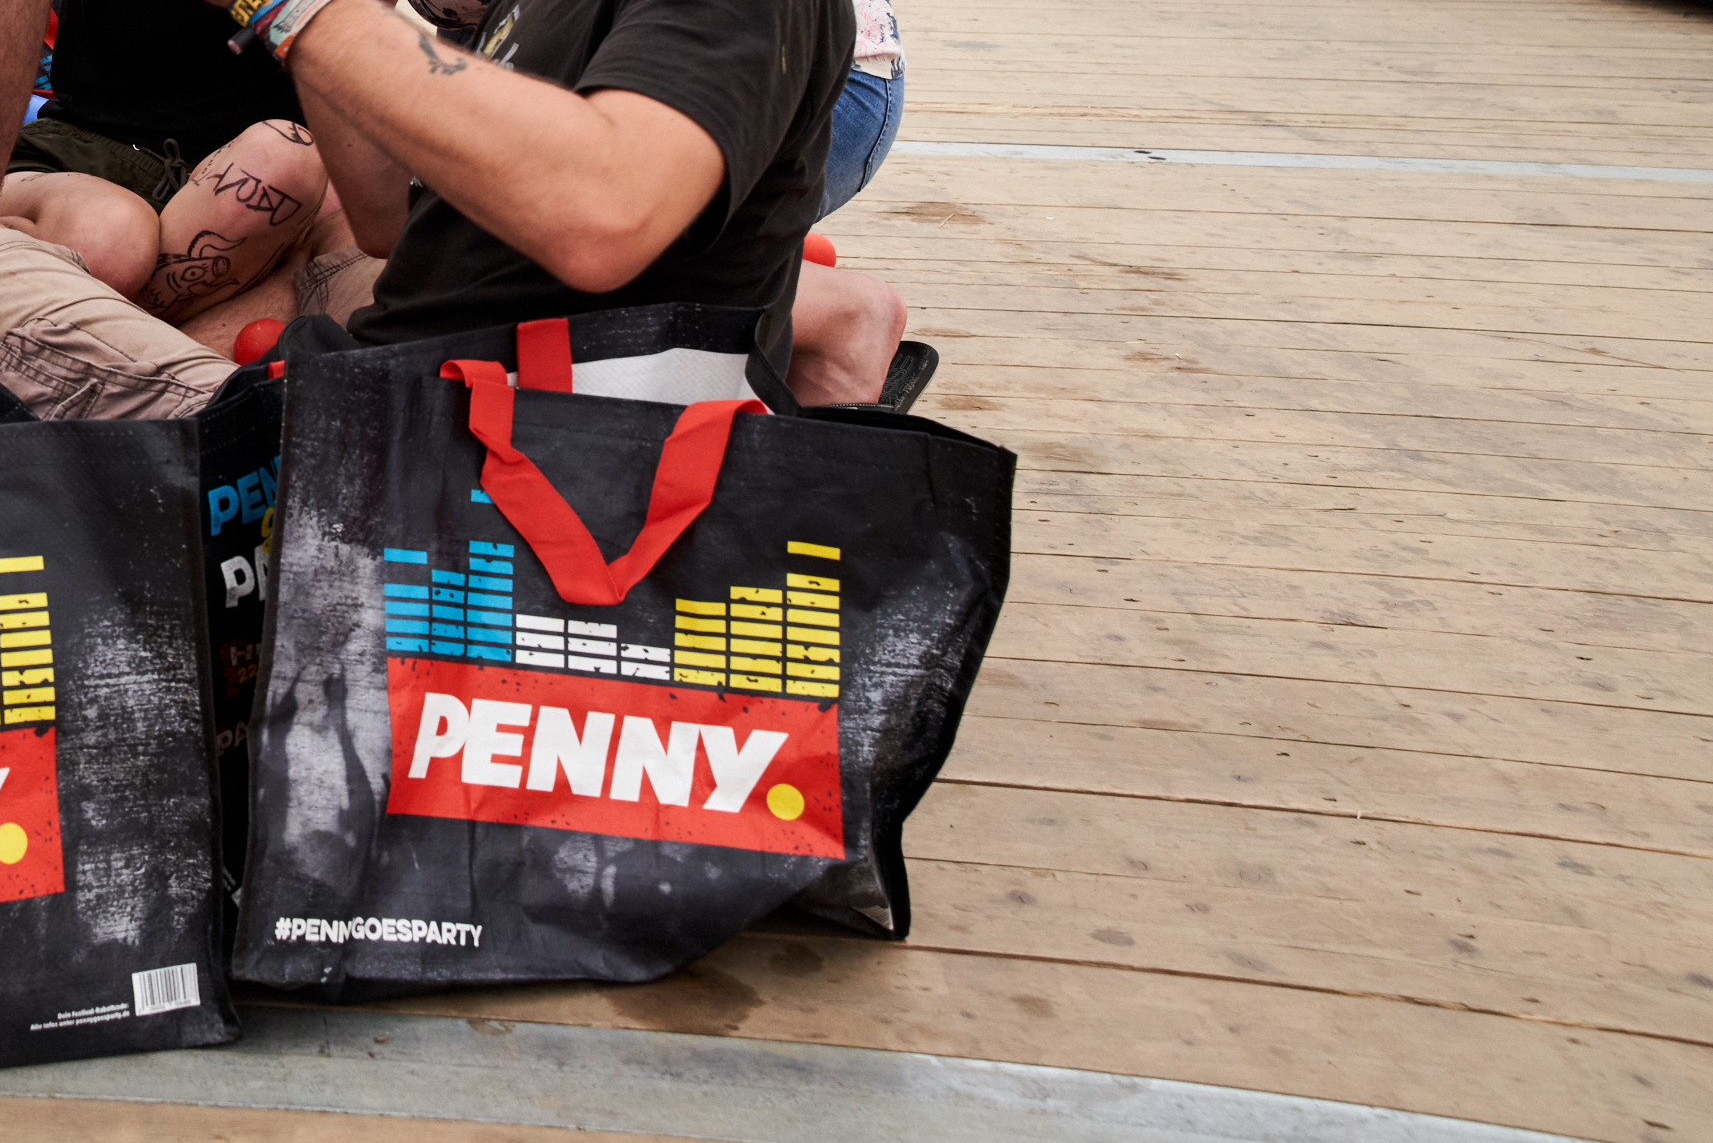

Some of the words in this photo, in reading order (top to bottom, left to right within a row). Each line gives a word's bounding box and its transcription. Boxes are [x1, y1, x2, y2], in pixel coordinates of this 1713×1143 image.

[207, 455, 281, 537] PEN
[405, 691, 807, 822] PENNY.
[274, 916, 483, 948] #PENNGOESPARTY
